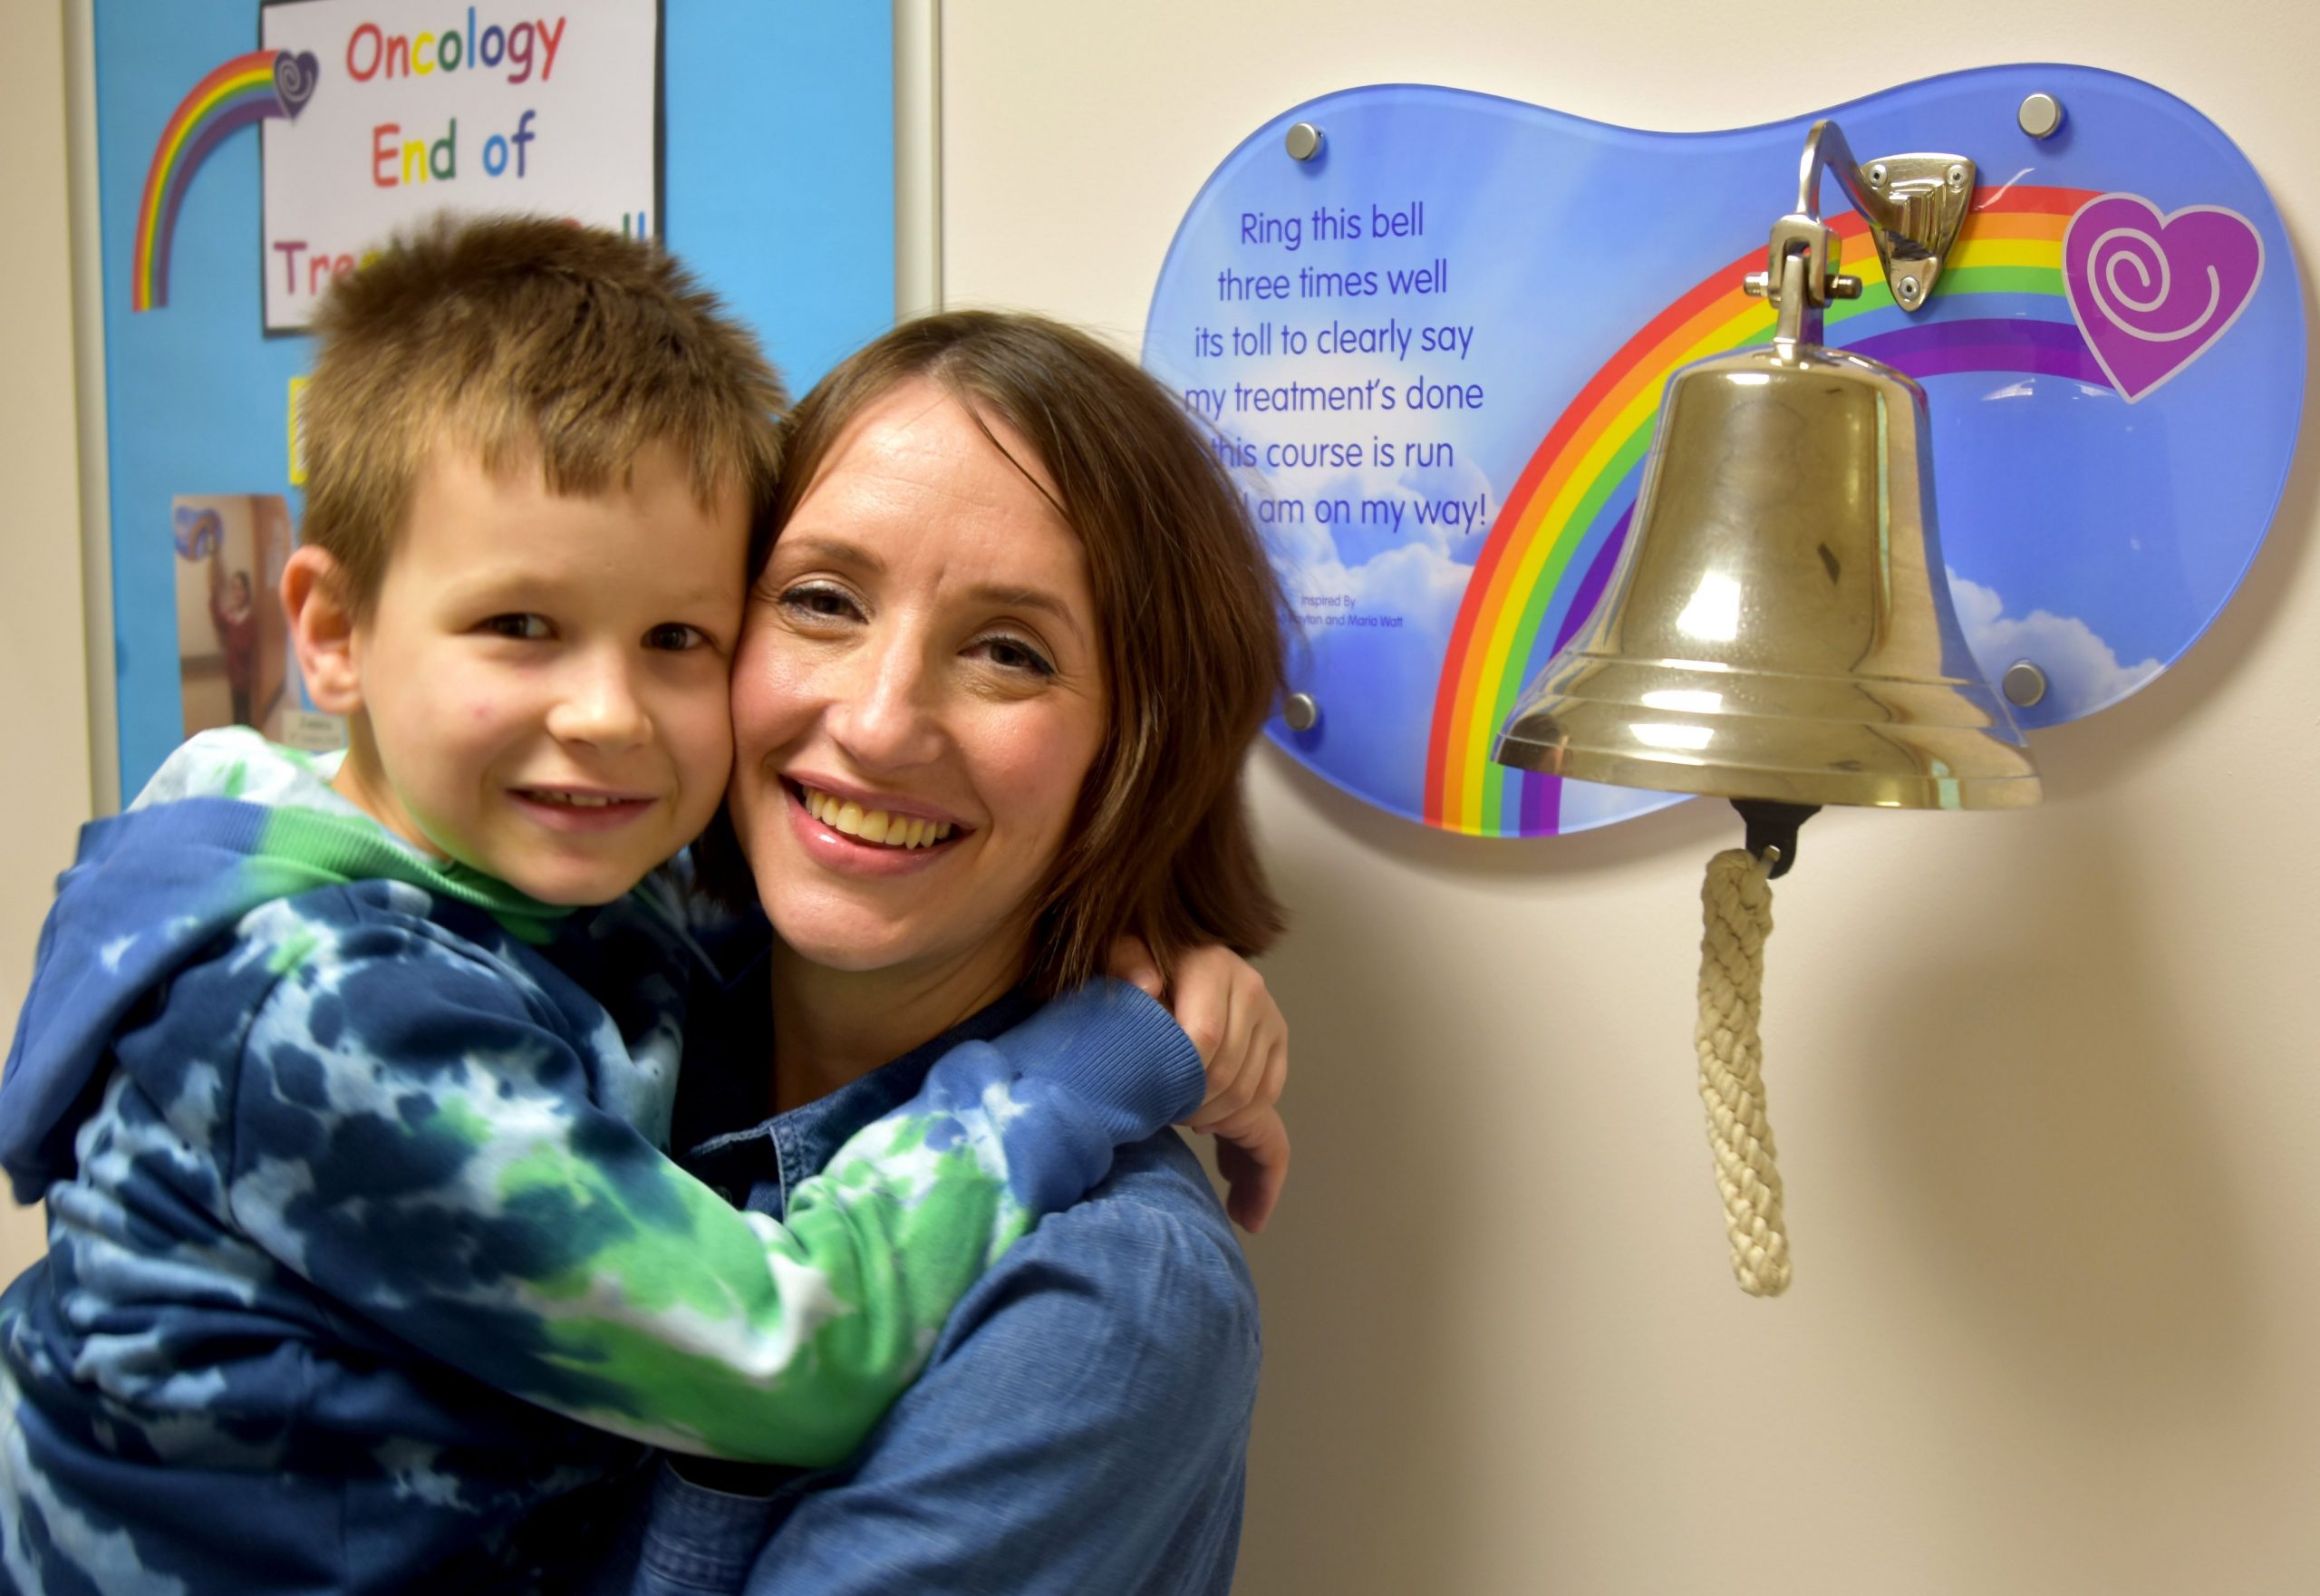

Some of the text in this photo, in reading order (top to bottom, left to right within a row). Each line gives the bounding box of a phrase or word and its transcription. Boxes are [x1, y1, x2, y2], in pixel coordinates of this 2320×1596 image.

[346, 6, 566, 83] Oncology
[372, 110, 536, 187] End of
[1241, 201, 1423, 251] Ring this bell
[1218, 258, 1446, 301] three times well
[1194, 318, 1474, 362] its toll to clearly say
[1185, 374, 1484, 421] my treatment's done
[1267, 442, 1363, 468] course
[1373, 435, 1395, 468] is
[1405, 442, 1454, 468] run
[1258, 499, 1304, 523] am
[1315, 498, 1350, 524] on
[1361, 498, 1406, 534] my
[1414, 493, 1485, 535] way!
[1301, 595, 1356, 609] Inspired By
[1325, 614, 1345, 625] and
[1348, 615, 1378, 627] Maria
[1380, 616, 1403, 628] Watt
